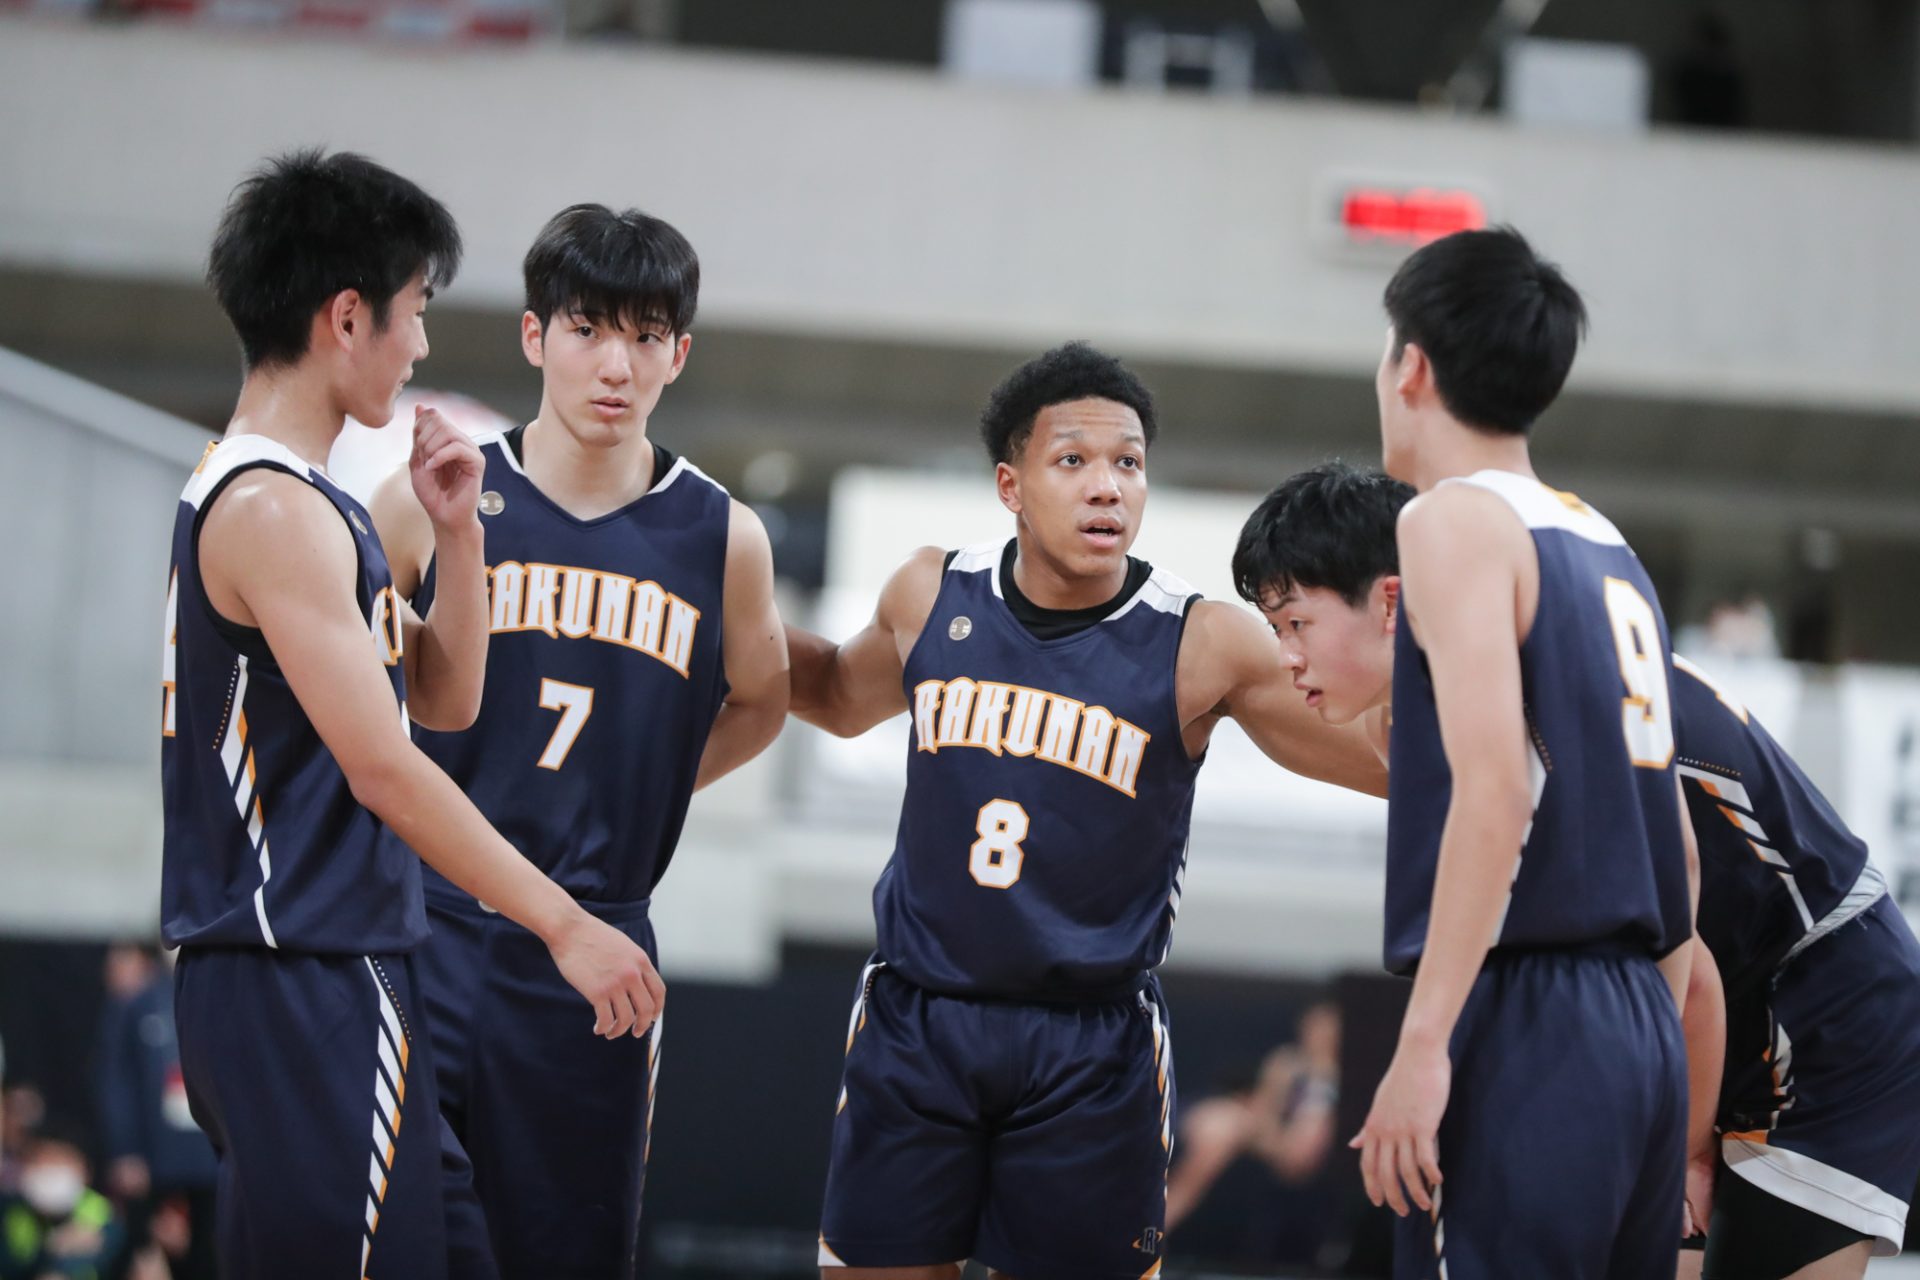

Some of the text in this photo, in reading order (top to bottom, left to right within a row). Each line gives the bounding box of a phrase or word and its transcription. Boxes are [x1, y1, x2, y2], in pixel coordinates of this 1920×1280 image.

[485, 560, 701, 680] AKUNAN
[1604, 575, 1675, 769] 9
[537, 677, 594, 771] 7
[914, 676, 1151, 799] RAKUNAN
[969, 798, 1030, 889] 8
